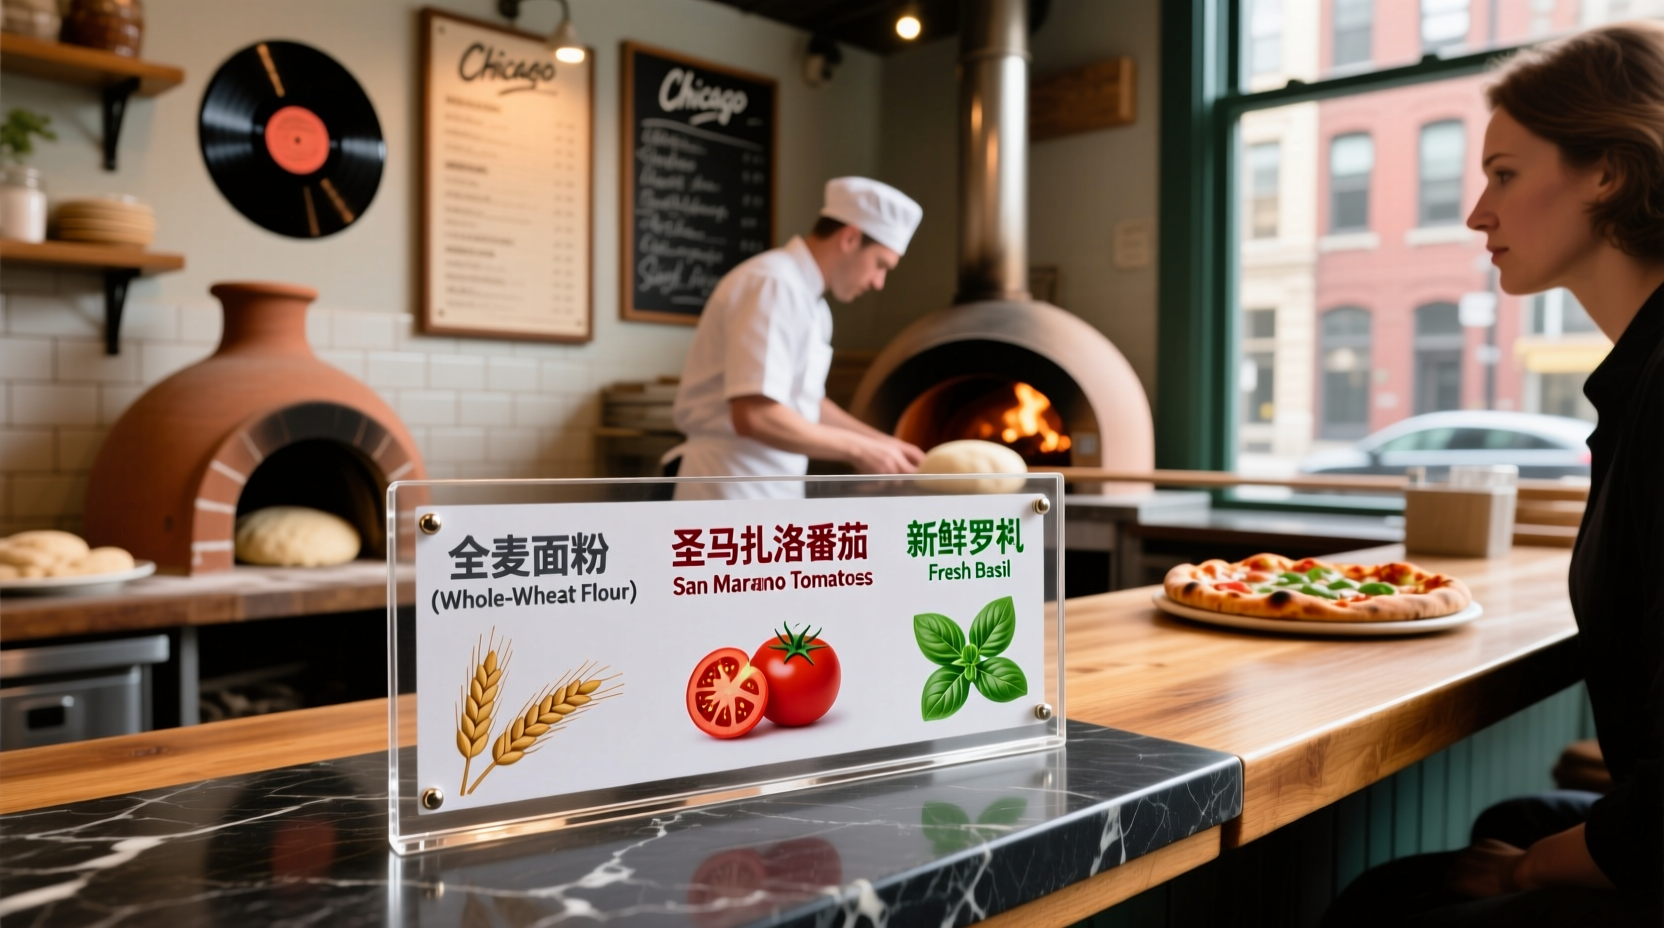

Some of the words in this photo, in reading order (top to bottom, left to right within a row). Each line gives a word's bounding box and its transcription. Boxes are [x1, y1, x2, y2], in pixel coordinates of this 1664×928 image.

[458, 41, 556, 92] Chicago
[658, 67, 748, 125] Chicago
[448, 532, 609, 580] 全麦面粉
[672, 521, 868, 567] 圣马扎洛番茄
[673, 576, 708, 596] San
[928, 561, 971, 581] Fresh
[975, 559, 1011, 579] Basil
[431, 585, 577, 615] (Whole-Wheat
[581, 580, 637, 605] Flour)
